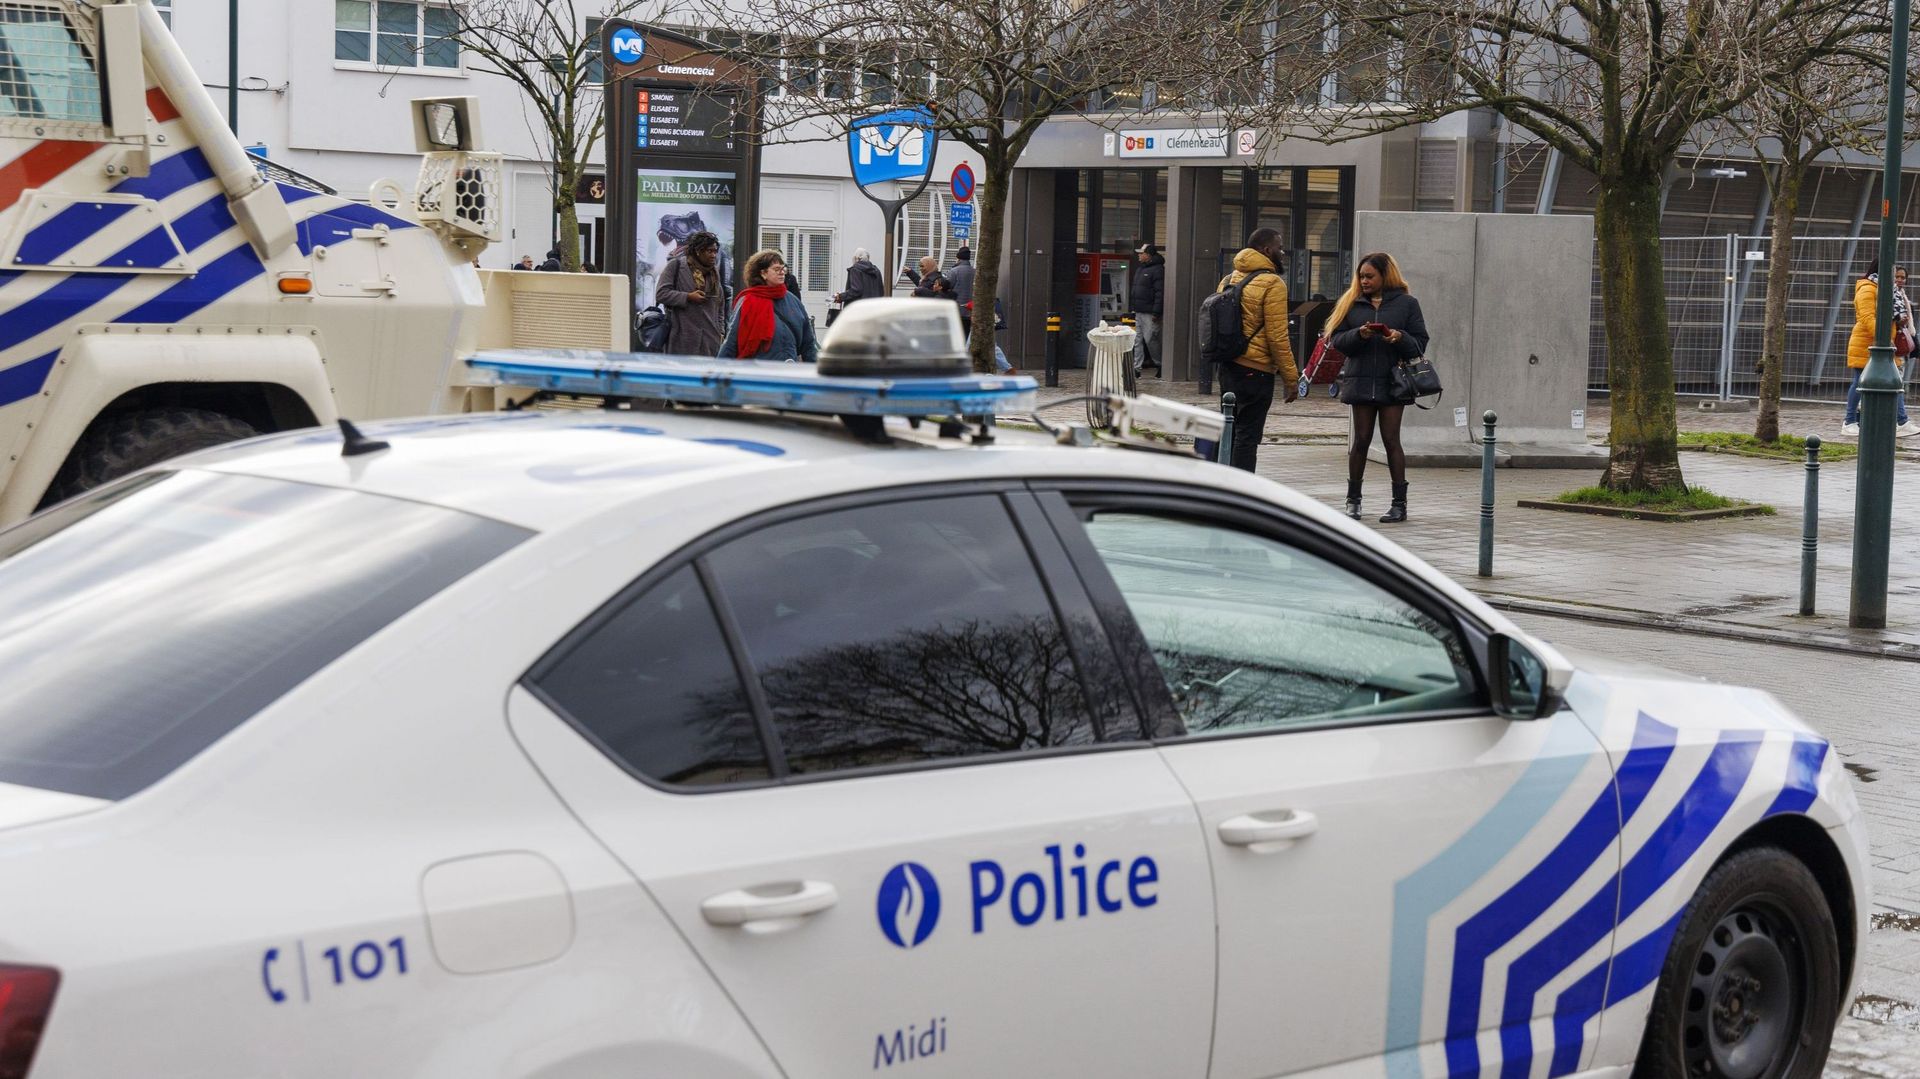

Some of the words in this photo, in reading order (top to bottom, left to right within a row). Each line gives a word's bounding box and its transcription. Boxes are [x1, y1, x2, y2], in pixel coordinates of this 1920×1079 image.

[650, 105, 679, 113] ELISABETH
[650, 116, 679, 124] ELISABETH
[642, 180, 681, 193] PAIRI
[687, 182, 731, 195] DAIZA
[969, 843, 1159, 934] Police
[322, 937, 409, 985] 101
[873, 1017, 947, 1069] Midi
